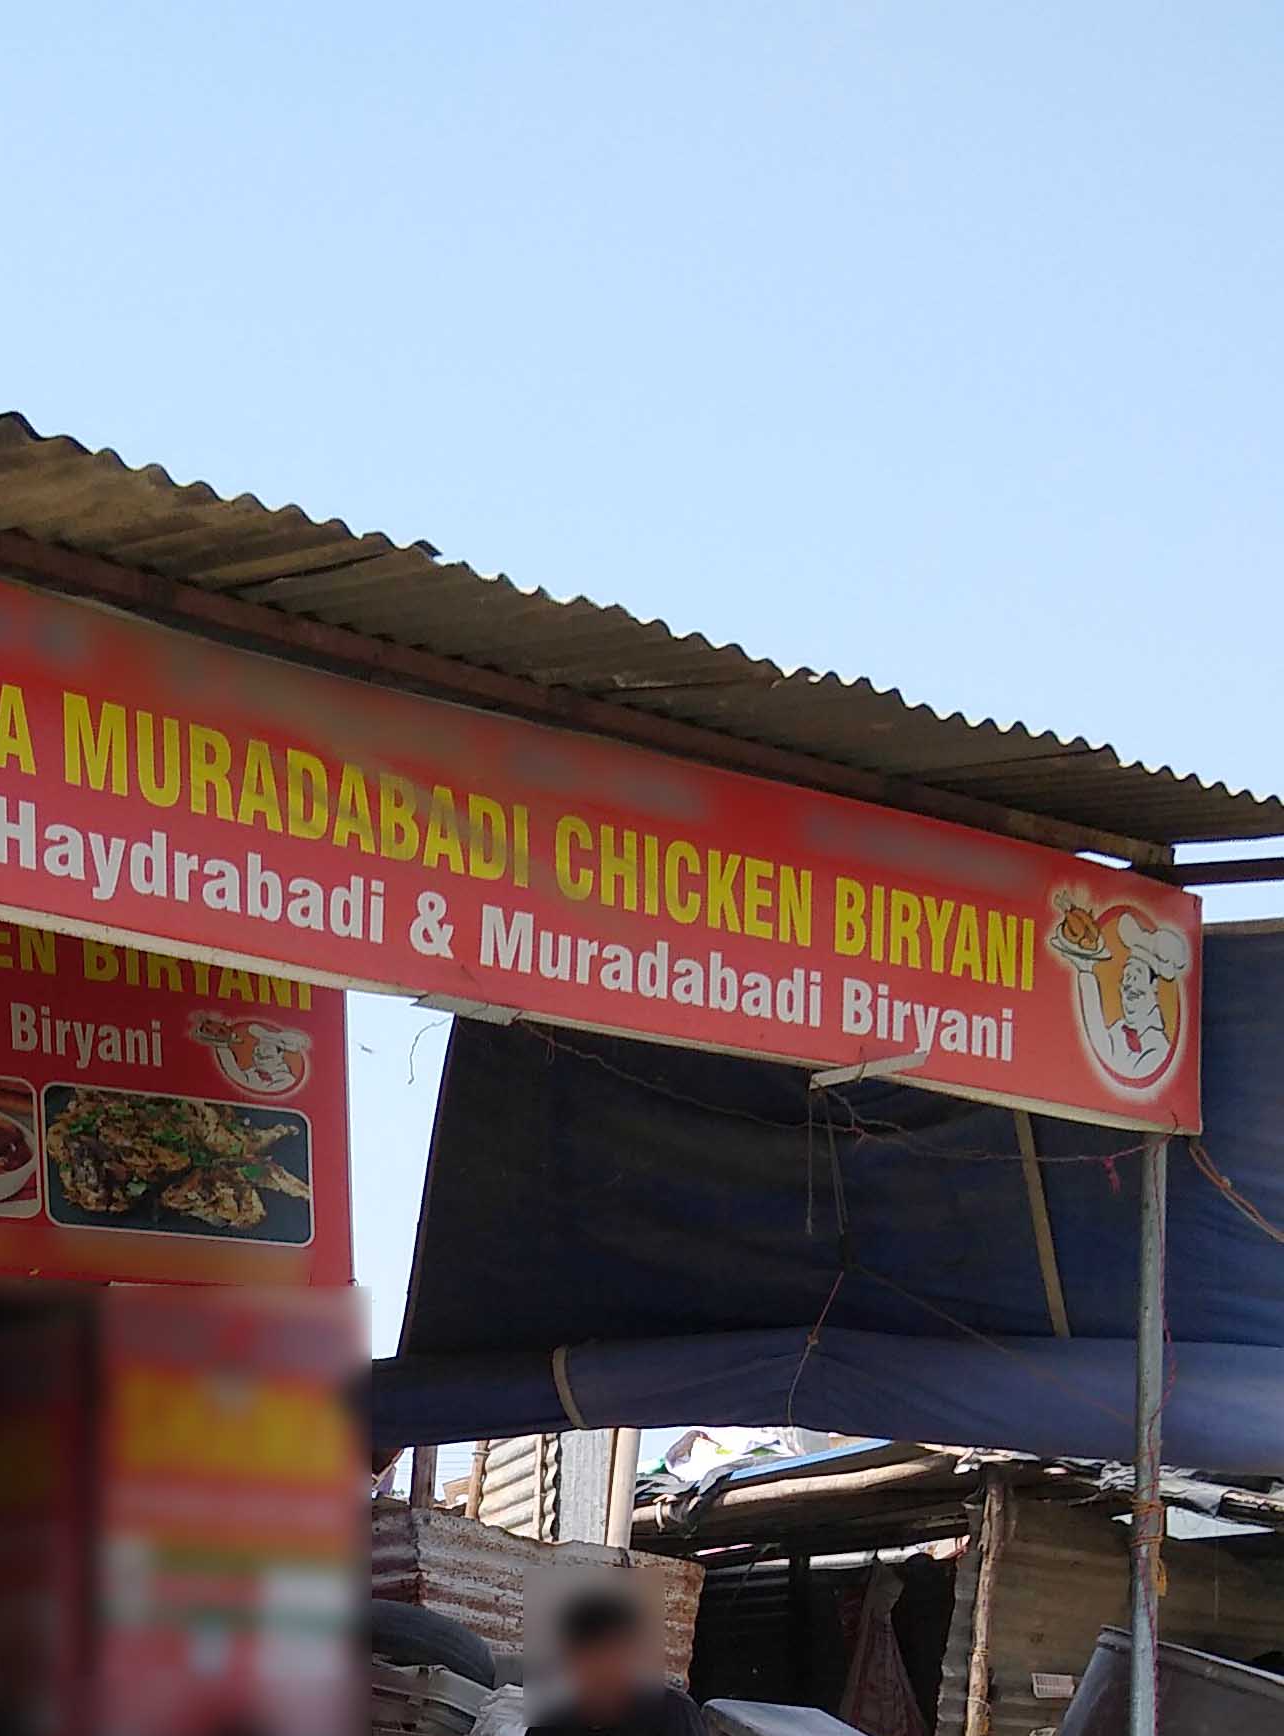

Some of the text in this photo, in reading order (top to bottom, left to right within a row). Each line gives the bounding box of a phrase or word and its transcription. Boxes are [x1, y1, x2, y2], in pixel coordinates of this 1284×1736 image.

[63, 691, 530, 885] MURADABADI
[555, 814, 813, 947] CHICKEN
[833, 876, 1035, 993] BIRYANI
[10, 1002, 163, 1068] Biryani
[409, 890, 454, 960] &
[479, 903, 822, 1028] Muradabadi
[841, 976, 1014, 1062] Biryani
